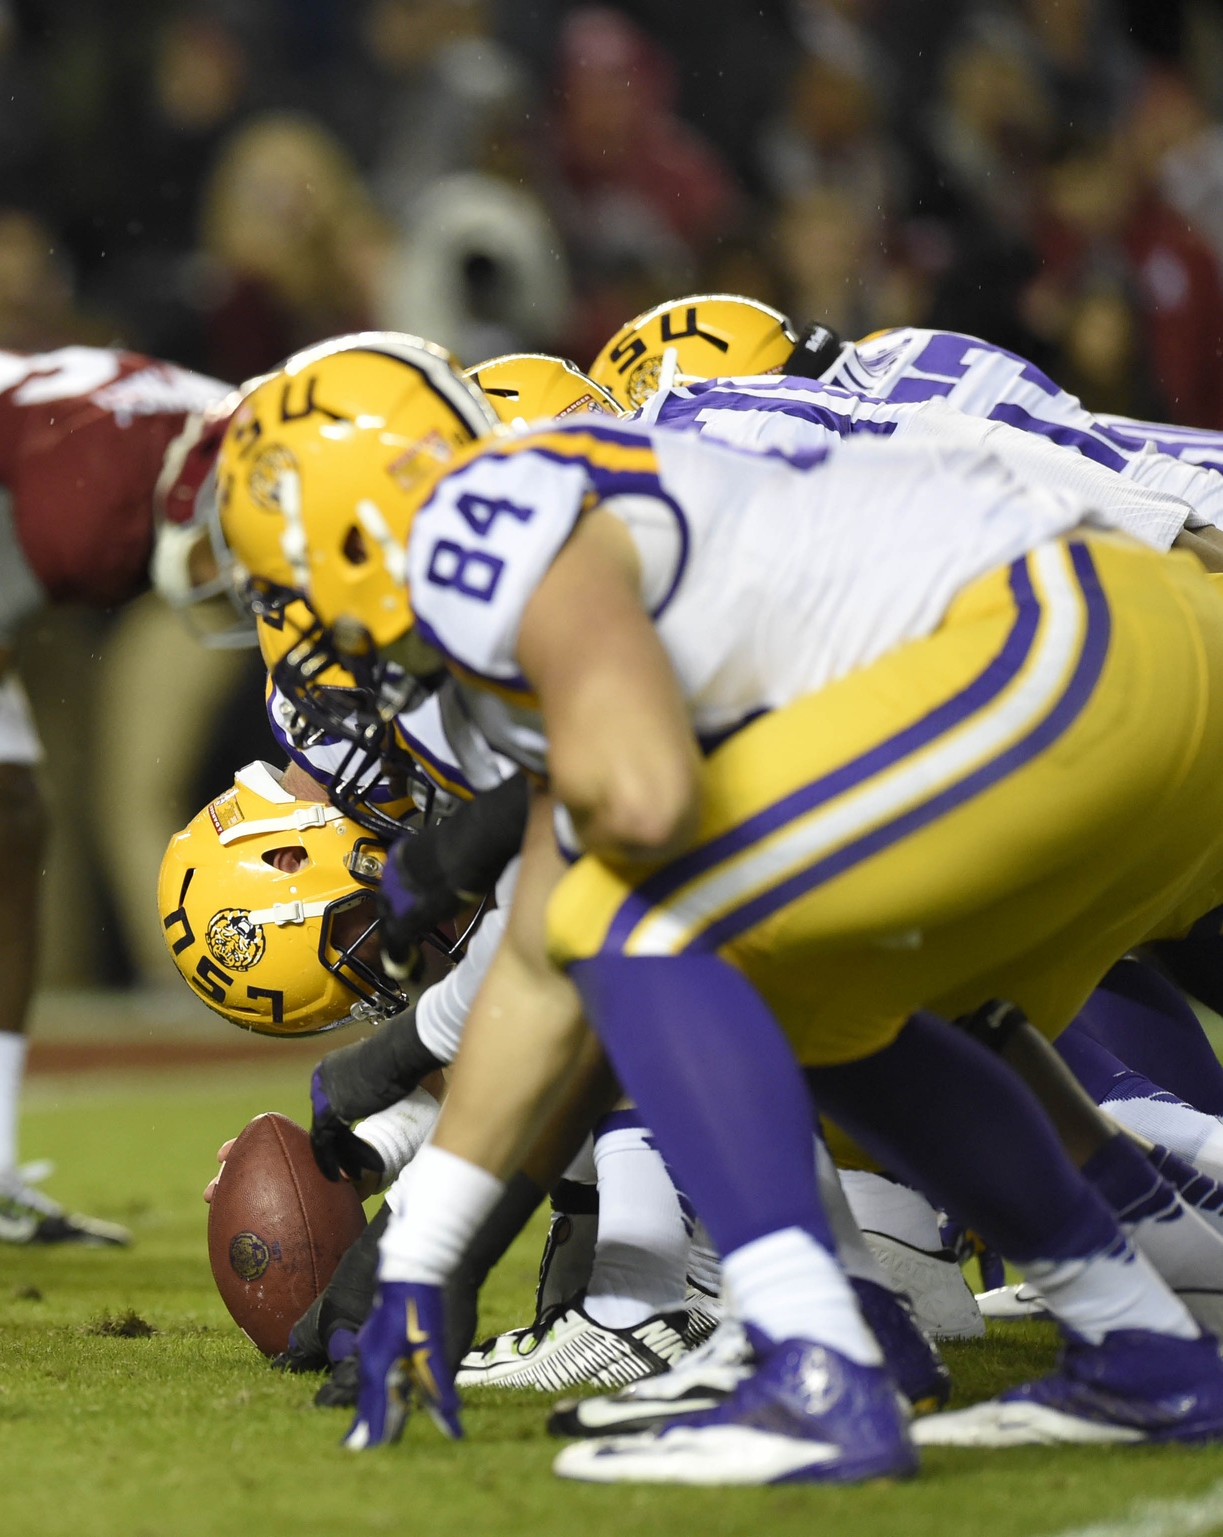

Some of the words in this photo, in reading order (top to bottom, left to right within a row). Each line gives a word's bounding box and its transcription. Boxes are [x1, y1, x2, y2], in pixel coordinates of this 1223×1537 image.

[606, 307, 697, 386] SU
[426, 493, 535, 604] 84
[164, 906, 284, 1023] LSU
[631, 1319, 687, 1368] NIK
